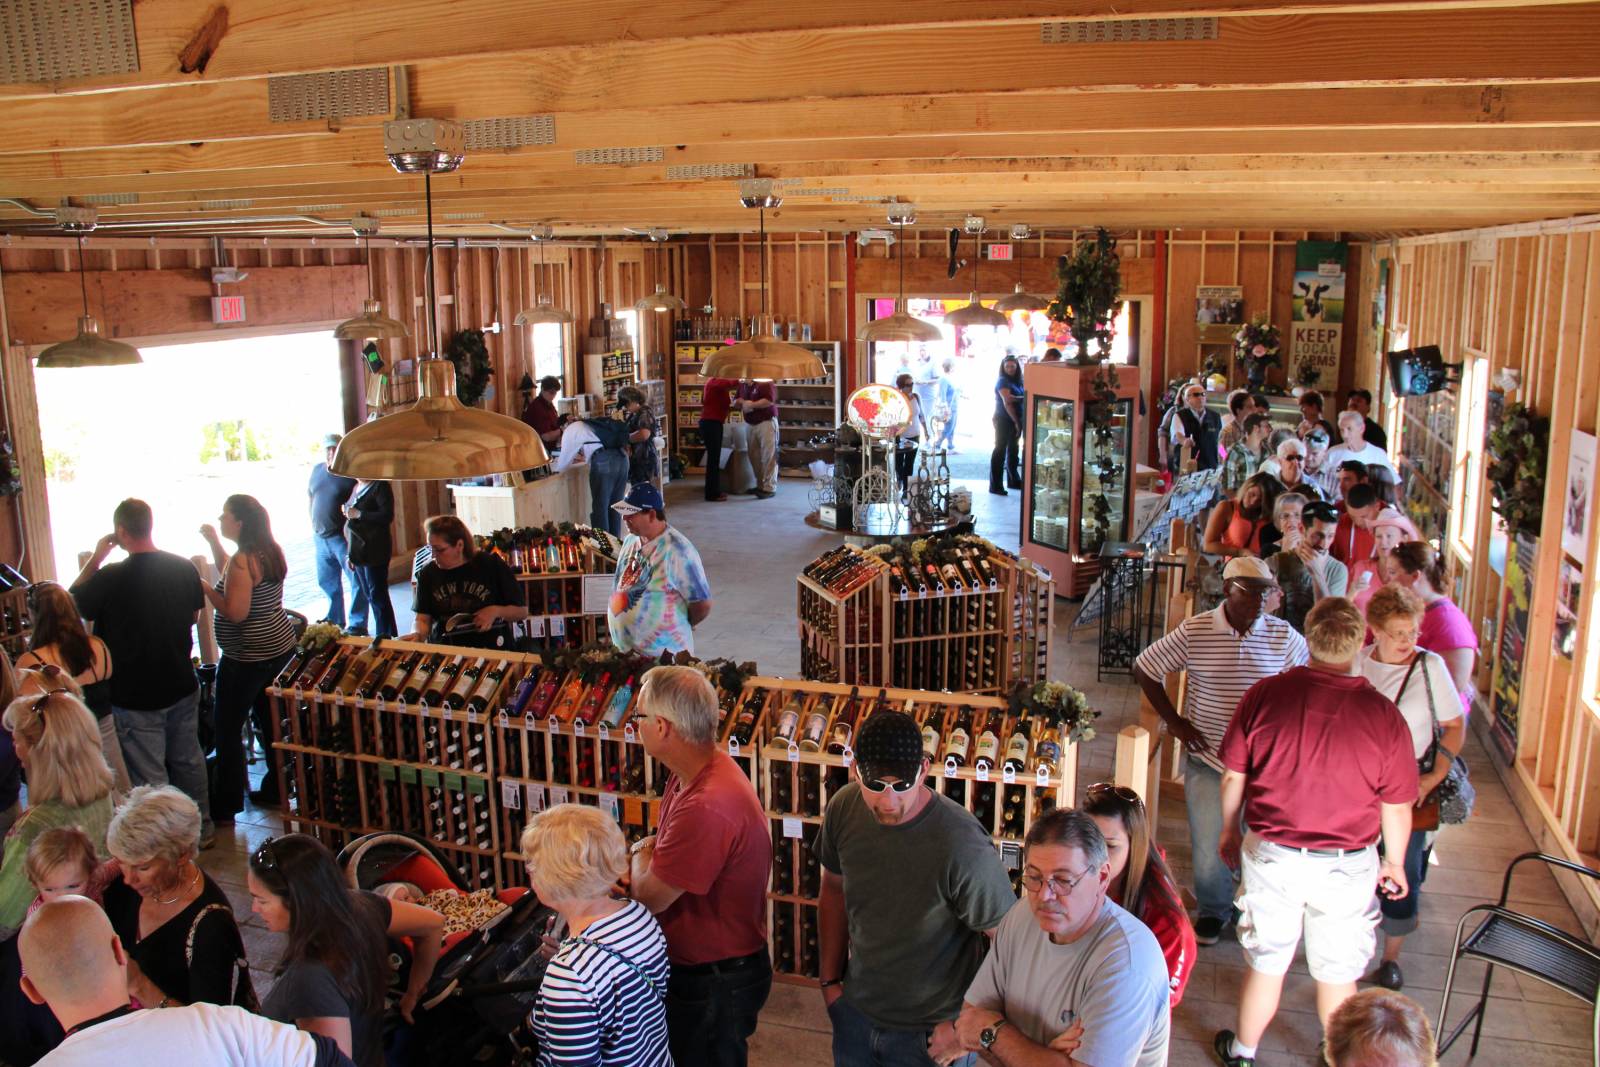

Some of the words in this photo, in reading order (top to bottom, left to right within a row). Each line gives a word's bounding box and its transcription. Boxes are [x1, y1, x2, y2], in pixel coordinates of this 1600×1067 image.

[992, 245, 1009, 258] EXIT
[221, 297, 241, 321] EXIT
[1296, 329, 1337, 343] KEEP
[1295, 343, 1336, 355] LOCAL
[1293, 355, 1336, 367] FARMS
[433, 581, 457, 602] NEW
[463, 580, 491, 601] YORK
